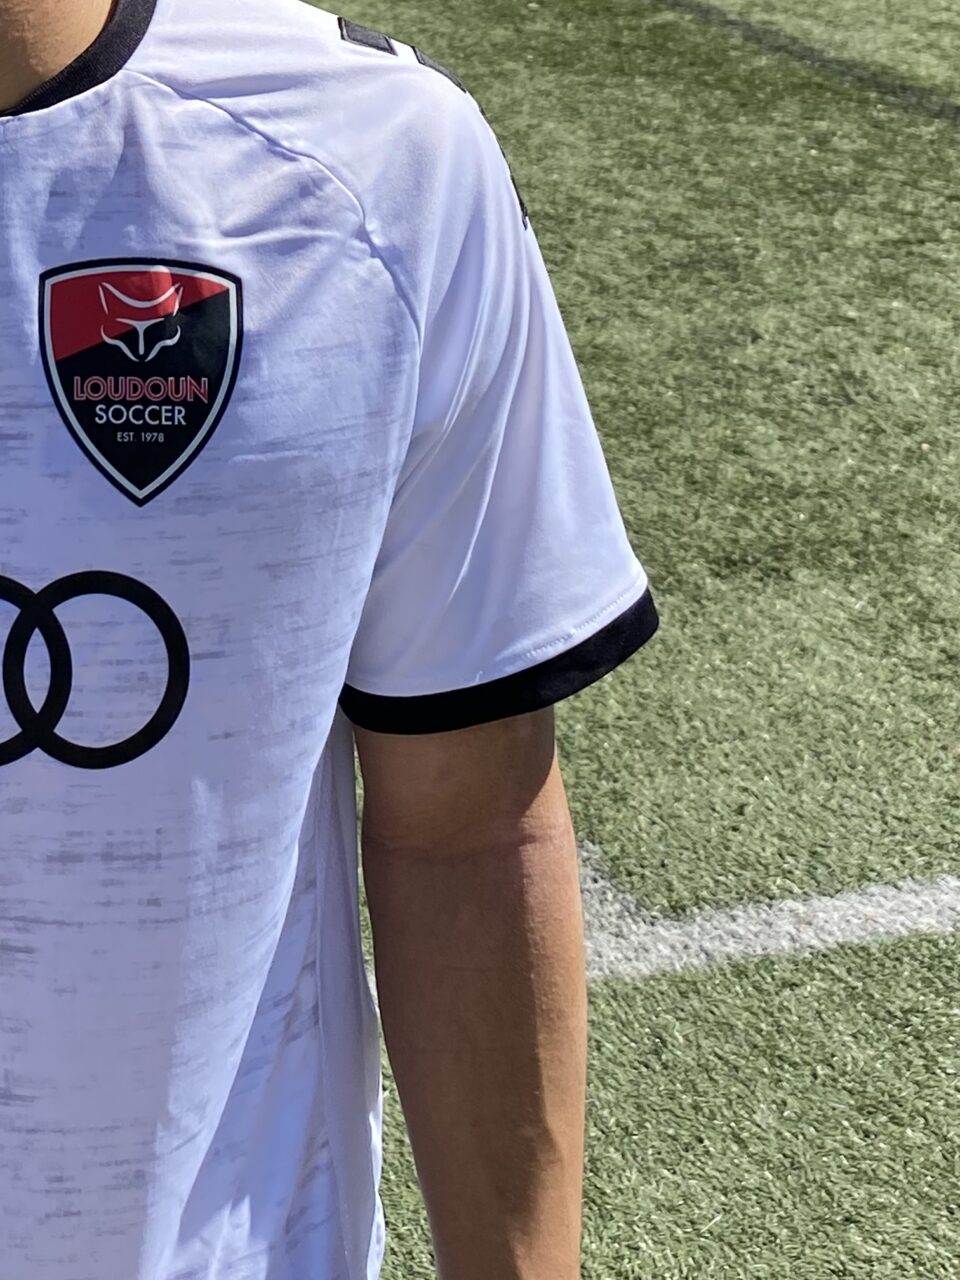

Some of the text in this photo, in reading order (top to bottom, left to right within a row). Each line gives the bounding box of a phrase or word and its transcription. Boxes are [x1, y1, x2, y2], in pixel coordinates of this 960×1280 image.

[74, 375, 209, 403] LOUDOUN
[95, 405, 187, 426] SOCCER
[141, 431, 165, 443] 1978
